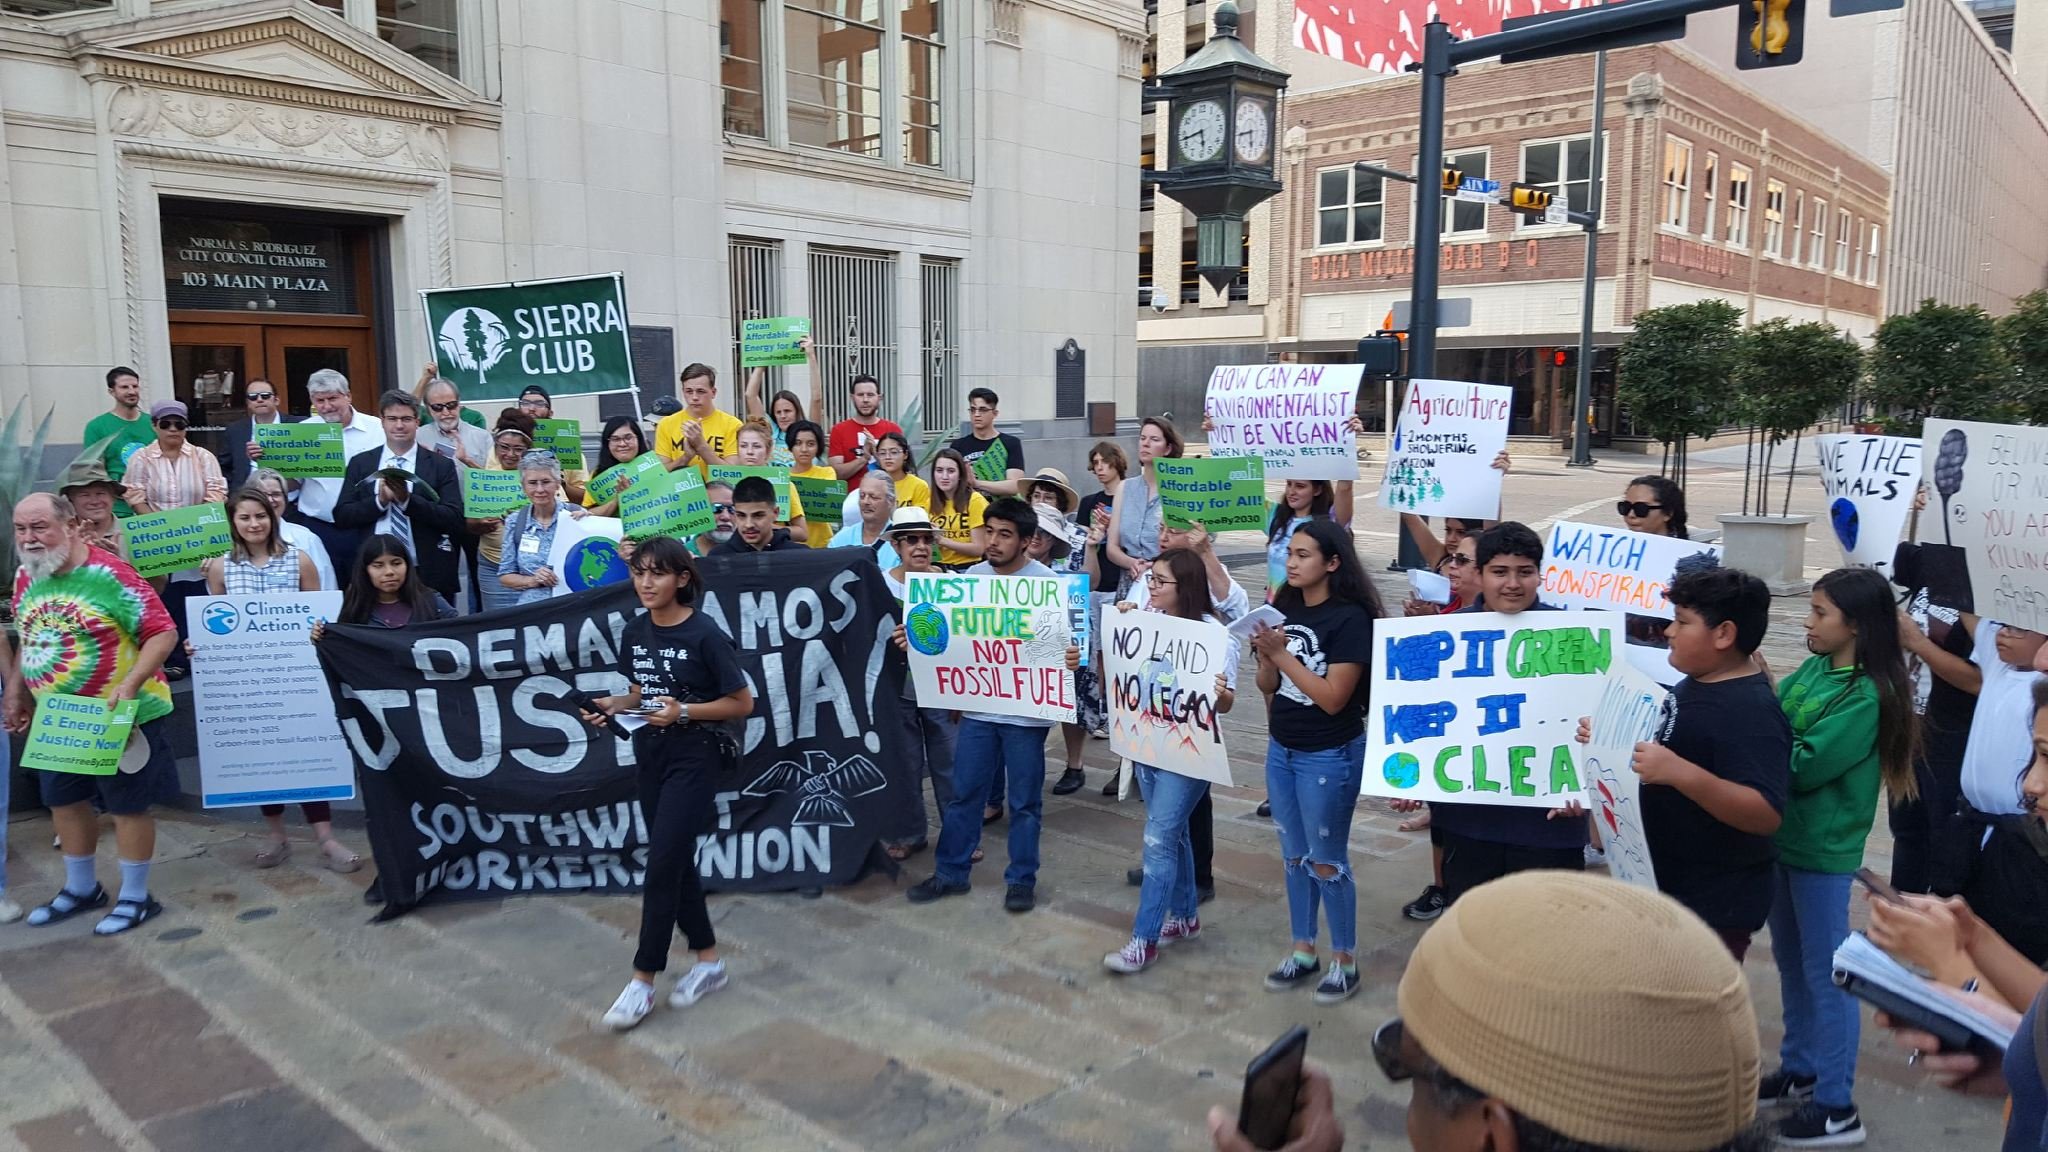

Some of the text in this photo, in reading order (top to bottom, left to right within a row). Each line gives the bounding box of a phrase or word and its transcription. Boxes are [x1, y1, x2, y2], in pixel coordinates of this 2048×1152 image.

[1462, 180, 1484, 192] AIN
[189, 236, 317, 256] NORMA S. RODRIGUEZ
[179, 250, 328, 269] CITY COUNCIL CHAMBER
[1311, 254, 1349, 280] BILL
[1441, 240, 1538, 270] BAR-B-Q
[182, 272, 330, 291] 103 MAIN PLAZA
[513, 299, 623, 340] SIERRA
[746, 323, 770, 331] Clean
[745, 331, 791, 340] Affordable
[744, 342, 789, 352] Energy for
[521, 339, 596, 375] CLUB
[1211, 365, 1325, 391] HOW CAN AN
[1206, 391, 1350, 419] ENVIRONMENTALIST
[1407, 383, 1508, 425] Agriculture
[258, 428, 291, 436] Clean
[1210, 420, 1352, 445] NOT BE VEGAN?
[1416, 433, 1468, 443] MONTHS
[259, 440, 321, 448] Affordable
[1210, 448, 1240, 457] WHEN
[1407, 443, 1477, 454] SHOWERING
[260, 452, 344, 463] Energy for All!
[1860, 438, 1922, 476] THE
[470, 471, 515, 481] Climate
[711, 468, 743, 478] Clean
[1157, 462, 1194, 475] Clean
[471, 482, 479, 490] &
[590, 467, 627, 492] Climate
[1160, 479, 1233, 492] Affordable
[470, 494, 513, 503] Justice
[621, 488, 650, 504] Clean
[623, 492, 680, 518] Affordable
[1161, 495, 1263, 512] Energy for All!
[126, 518, 167, 530] Clean
[623, 499, 709, 532] Energy for All!
[1981, 508, 2015, 539] YOU
[131, 524, 204, 544] Affordable
[133, 533, 231, 559] Energy for All!
[1552, 525, 1647, 571] WATCH
[909, 577, 1061, 608] INVEST IN OUR
[1545, 565, 1670, 610] COWSPIRACY
[245, 601, 311, 615] Climate
[246, 619, 301, 632] Action
[950, 606, 1035, 640] FUTURE
[631, 644, 689, 660] The &
[972, 639, 1023, 665] NOT
[1112, 626, 1209, 675] NO LAND
[1385, 627, 1613, 682] KEEP IT GREEN
[936, 665, 1074, 710] FOSSIL FUEL
[46, 697, 104, 715] Climate
[1115, 672, 1141, 712] NO
[1150, 683, 1222, 744] LEGACY
[42, 714, 110, 736] & Energy
[1383, 700, 1458, 746] KEEP
[35, 732, 123, 750] Justice Now!
